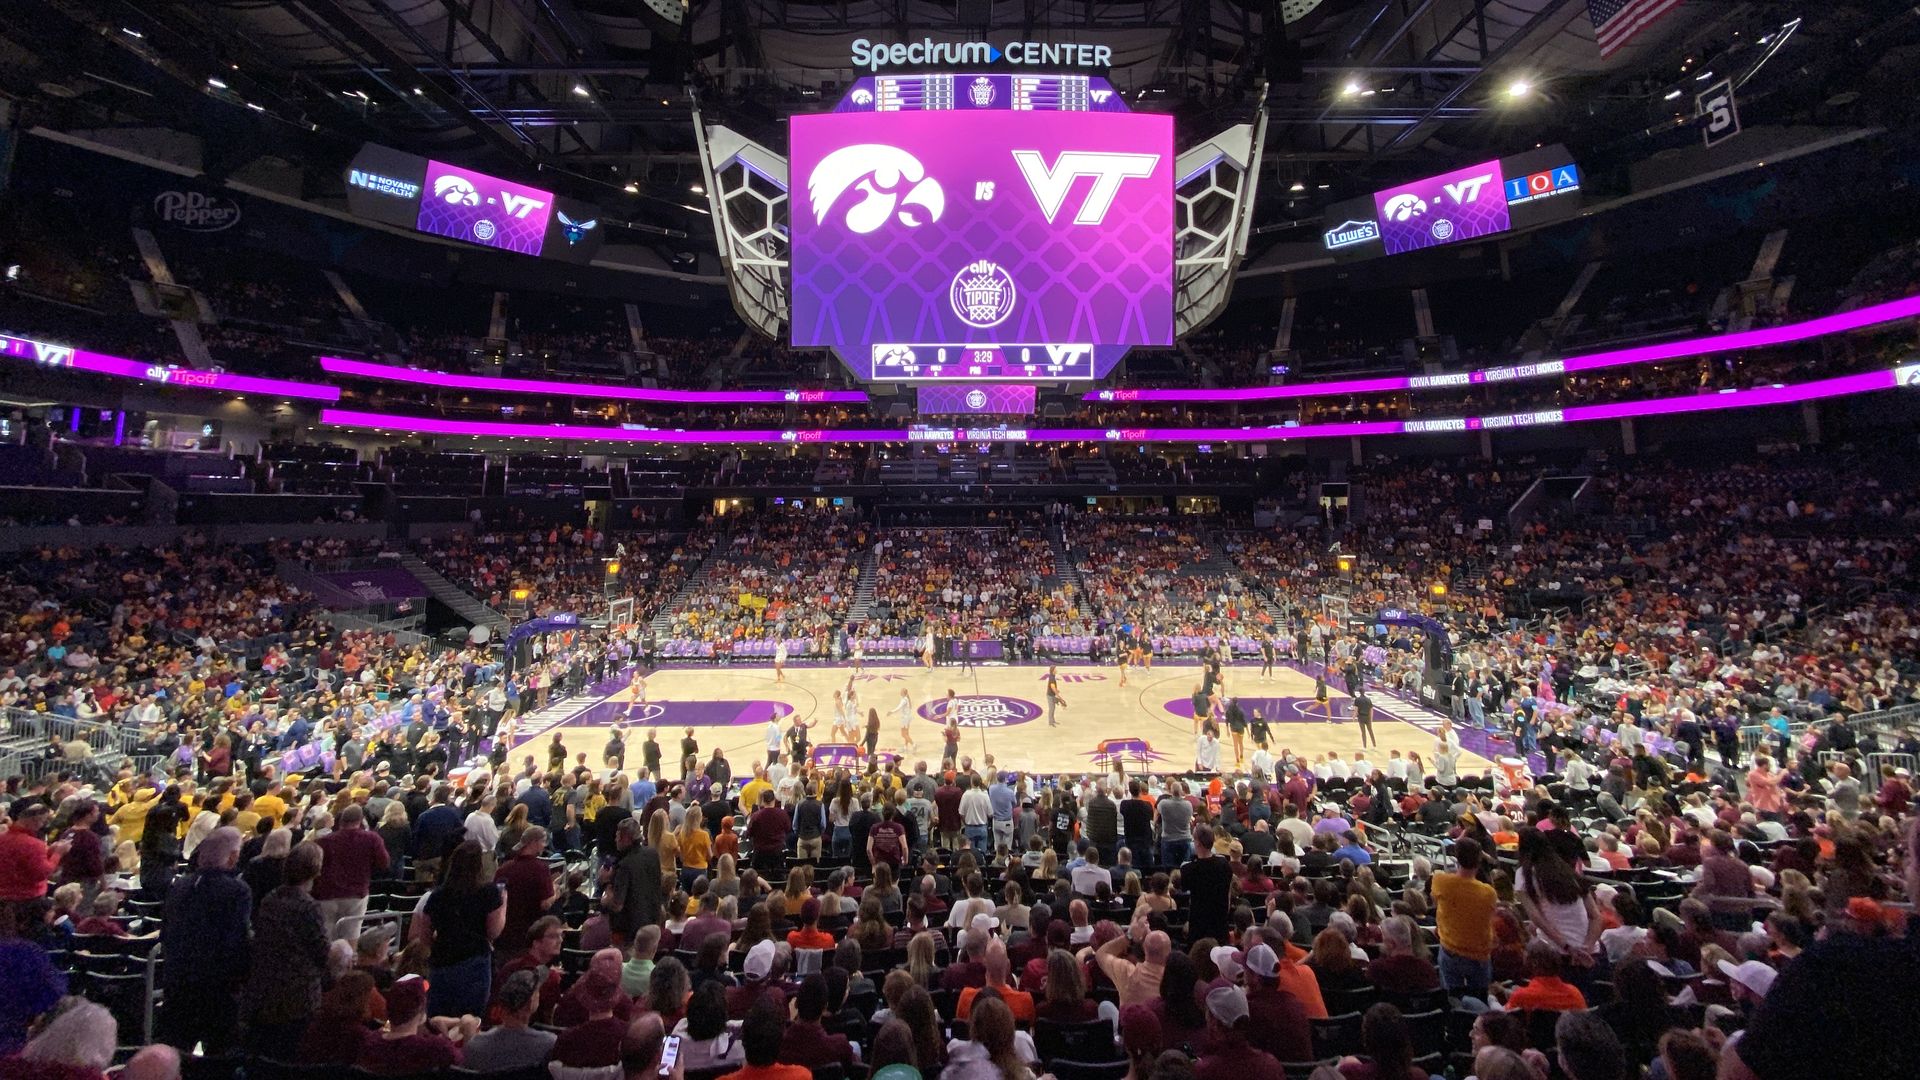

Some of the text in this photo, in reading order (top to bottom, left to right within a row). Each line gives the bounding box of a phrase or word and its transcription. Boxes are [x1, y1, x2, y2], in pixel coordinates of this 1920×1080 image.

[851, 38, 1112, 71] Spectrum CENTER
[1090, 90, 1113, 103] VT
[377, 183, 413, 198] HEALTH
[378, 176, 419, 191] NOVANT
[1011, 150, 1161, 225] VT
[1444, 173, 1493, 205] VT
[975, 182, 996, 201] VS
[163, 191, 235, 225] Pepper
[501, 190, 546, 219] VT
[1332, 225, 1374, 245] LOWE'S
[970, 260, 997, 276] ally
[966, 290, 1001, 306] TIPOFF
[937, 348, 947, 363] 0
[974, 350, 993, 363] 3:29
[1021, 347, 1031, 363] 0
[1044, 345, 1091, 366] VT
[147, 366, 218, 386] ally Tipoff
[1410, 377, 1430, 387] IOWA
[1430, 373, 1469, 386] HAWKEYES
[1485, 368, 1517, 381] VIRGINIA
[1517, 365, 1535, 378] TECH
[1536, 361, 1564, 375] HOKIES
[785, 392, 824, 402] ally Tipoff
[1099, 391, 1138, 400] ally Tipoff
[1405, 422, 1425, 432] IOWA
[1425, 419, 1465, 432] HAWKEYES
[1481, 416, 1515, 428] VIRGINIA
[1515, 413, 1534, 425] TECH
[1534, 410, 1563, 423] HOKIES
[781, 431, 822, 441] ally Tipoff
[908, 430, 924, 440] IOWA
[924, 430, 955, 440] HAWKEYES
[966, 430, 991, 440] VIRGINIA
[991, 430, 1006, 440] TECH
[1006, 430, 1027, 440] HOKIES
[1105, 430, 1146, 440] ally Tipoff
[554, 614, 571, 623] ally
[1385, 610, 1402, 619] ally
[912, 806, 925, 818] 24
[1510, 810, 1524, 823] 20
[1056, 816, 1070, 830] 22
